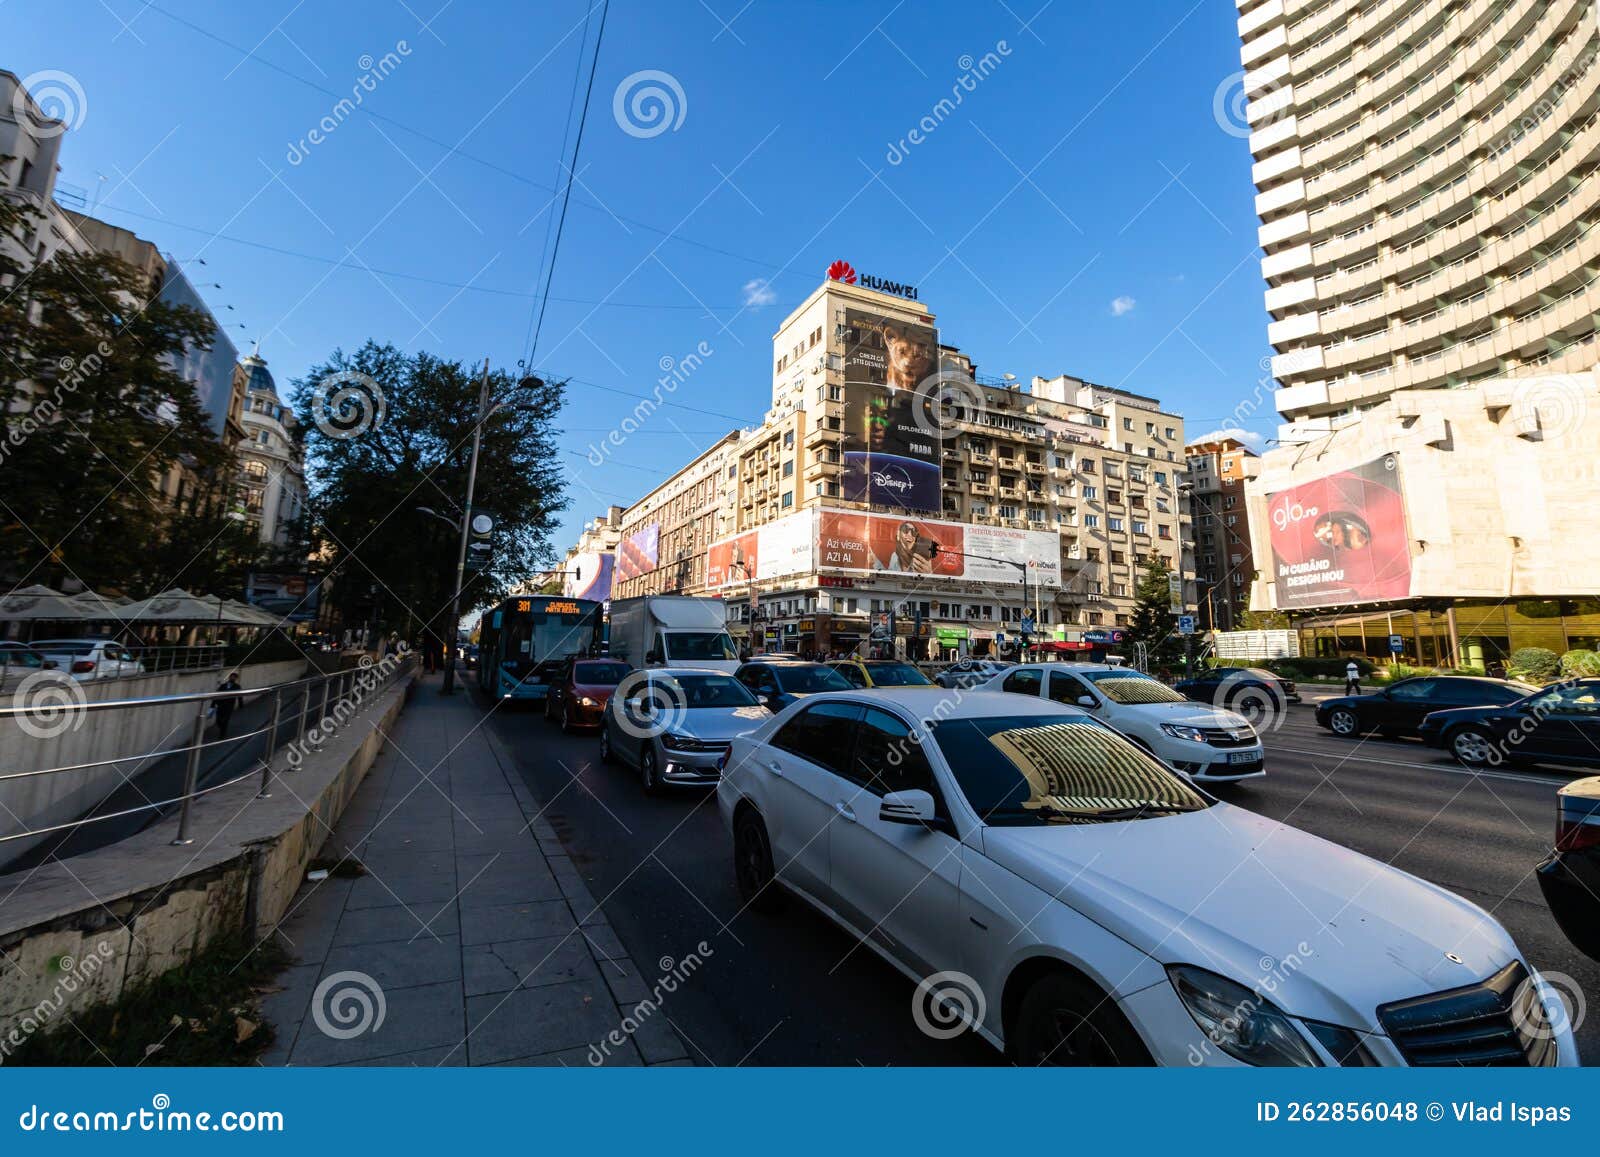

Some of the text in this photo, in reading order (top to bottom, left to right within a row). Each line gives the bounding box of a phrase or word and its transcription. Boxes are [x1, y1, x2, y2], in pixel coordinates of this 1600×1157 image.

[860, 273, 918, 300] HUAWEI
[826, 538, 840, 548] Azi
[826, 552, 841, 562] AZI
[1287, 569, 1345, 587] DESIGN NOU
